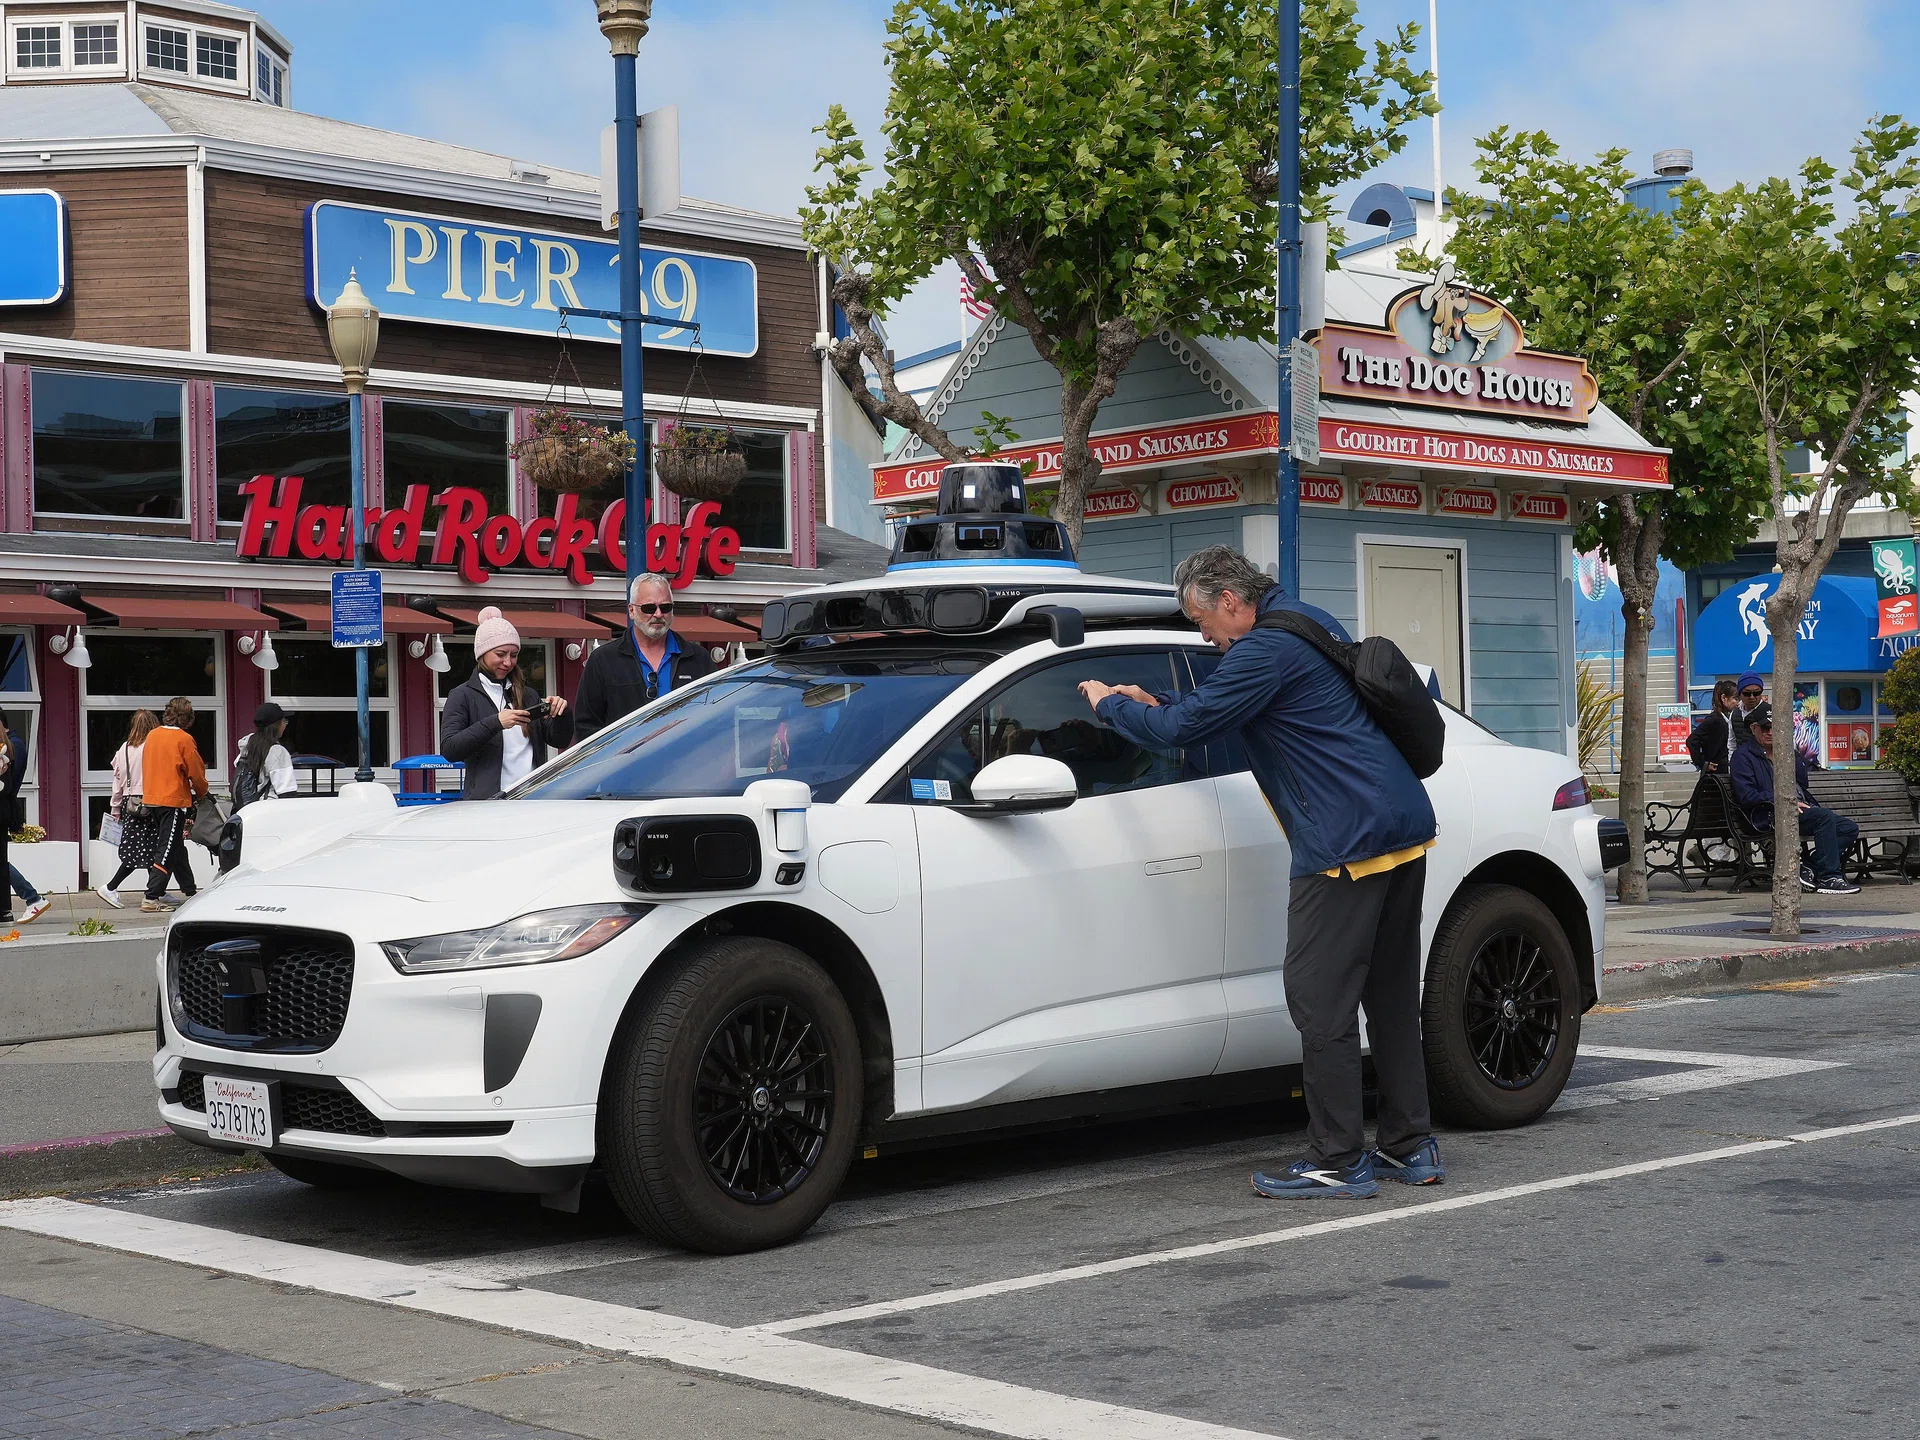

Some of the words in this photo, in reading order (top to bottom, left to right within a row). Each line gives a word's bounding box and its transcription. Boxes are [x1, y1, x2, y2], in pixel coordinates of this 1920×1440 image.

[384, 218, 587, 310] PIER
[1340, 346, 1403, 388] THE
[1409, 356, 1474, 396] DOG
[1480, 365, 1574, 408] HOUSE
[1036, 451, 1063, 472] DO
[1093, 444, 1132, 463] AND
[1137, 429, 1228, 459] SAUSAGES
[1335, 427, 1418, 455] GOURMET
[1423, 436, 1458, 459] HOT
[1463, 440, 1506, 464] DOGS
[1510, 448, 1543, 466] AND
[1547, 448, 1614, 473] SAUSAGES
[1172, 481, 1236, 503] CHOWDER
[1308, 482, 1340, 499] DOGS
[1084, 493, 1136, 513] AUSAGES
[1524, 501, 1557, 515] CHILI
[236, 473, 430, 562] Hard
[431, 485, 596, 586] Rock
[599, 497, 741, 590] Cafe
[1886, 612, 1915, 620] aquarium
[1796, 619, 1820, 640] AY
[235, 905, 287, 913] JAGUAR
[217, 1082, 257, 1102] California
[209, 1100, 266, 1136] 35787X3
[224, 1132, 257, 1142] dmv.ca.gov
